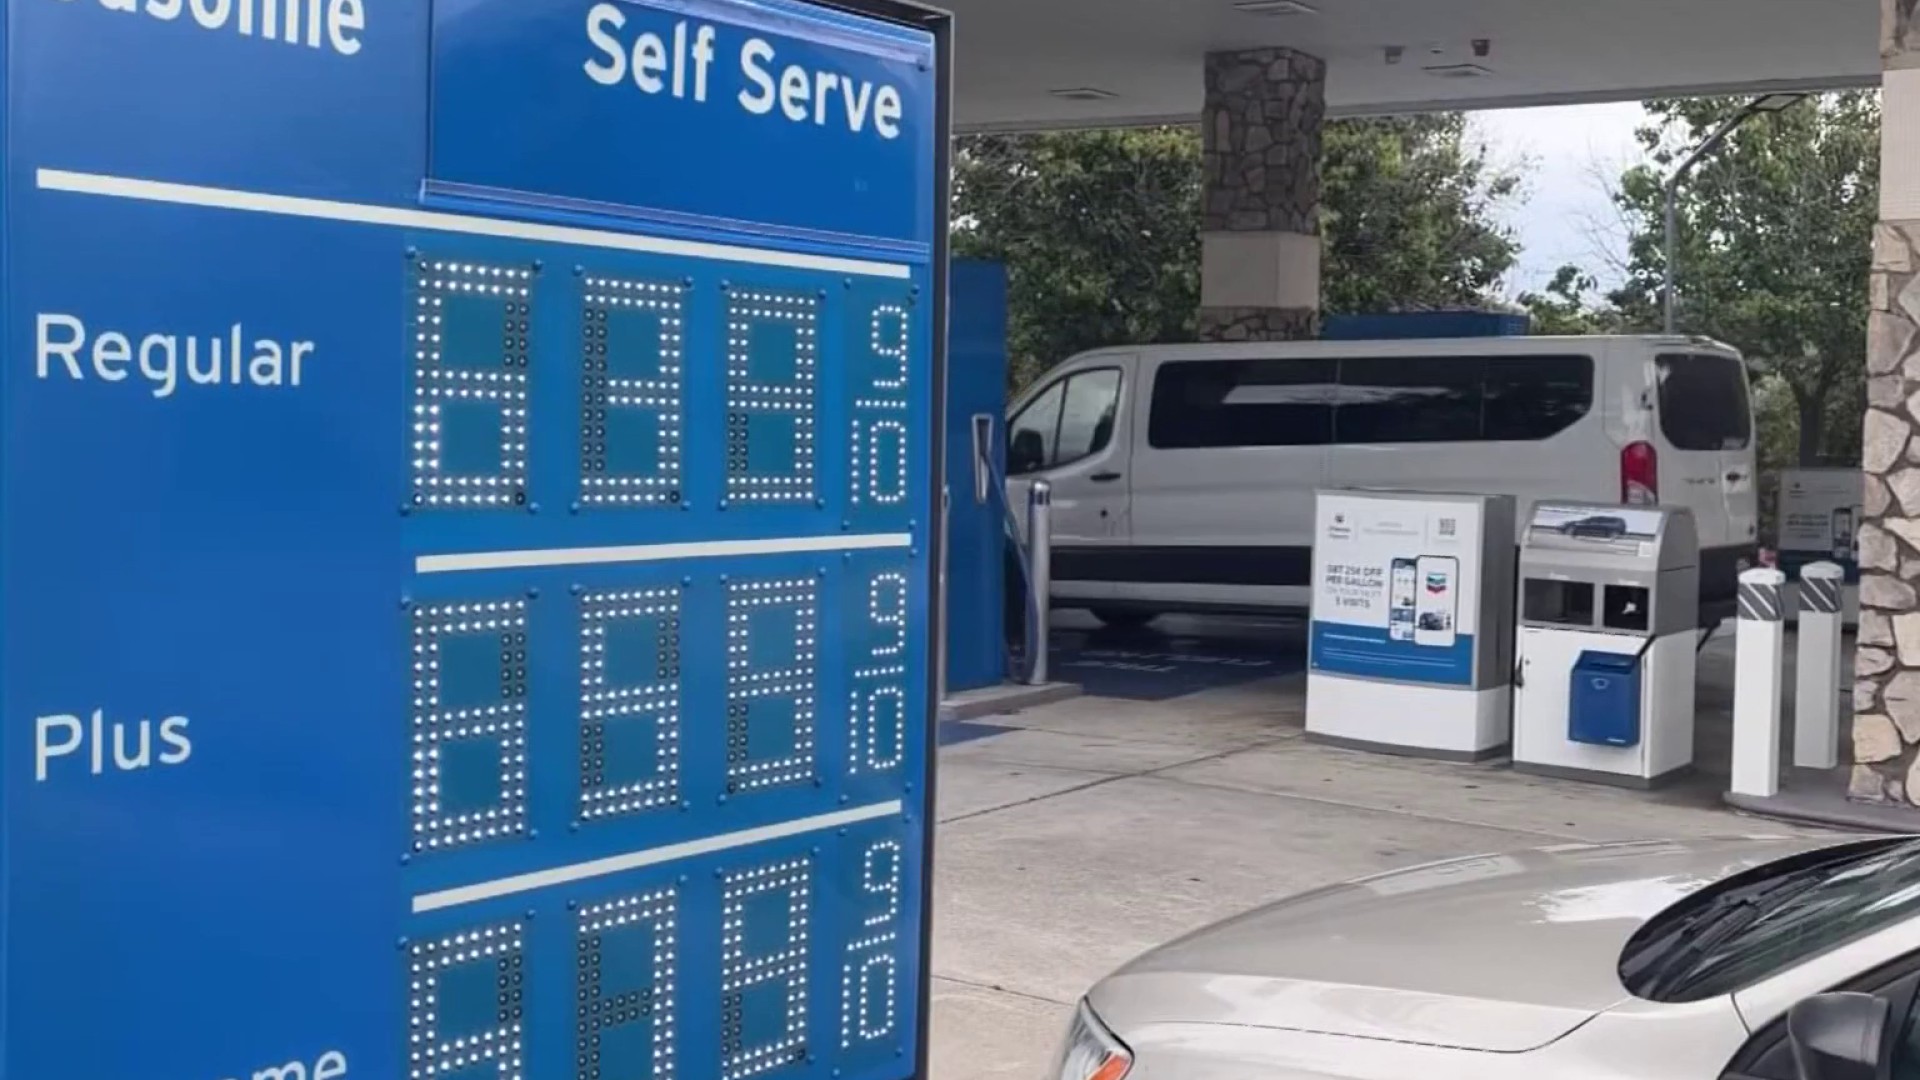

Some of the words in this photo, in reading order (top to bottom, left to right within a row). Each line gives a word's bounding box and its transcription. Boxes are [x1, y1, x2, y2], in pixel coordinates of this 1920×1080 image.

[58, 0, 365, 55] oline
[584, 3, 715, 101] Self
[738, 37, 905, 139] Serve
[36, 313, 315, 398] Regular
[35, 710, 192, 781] Plus
